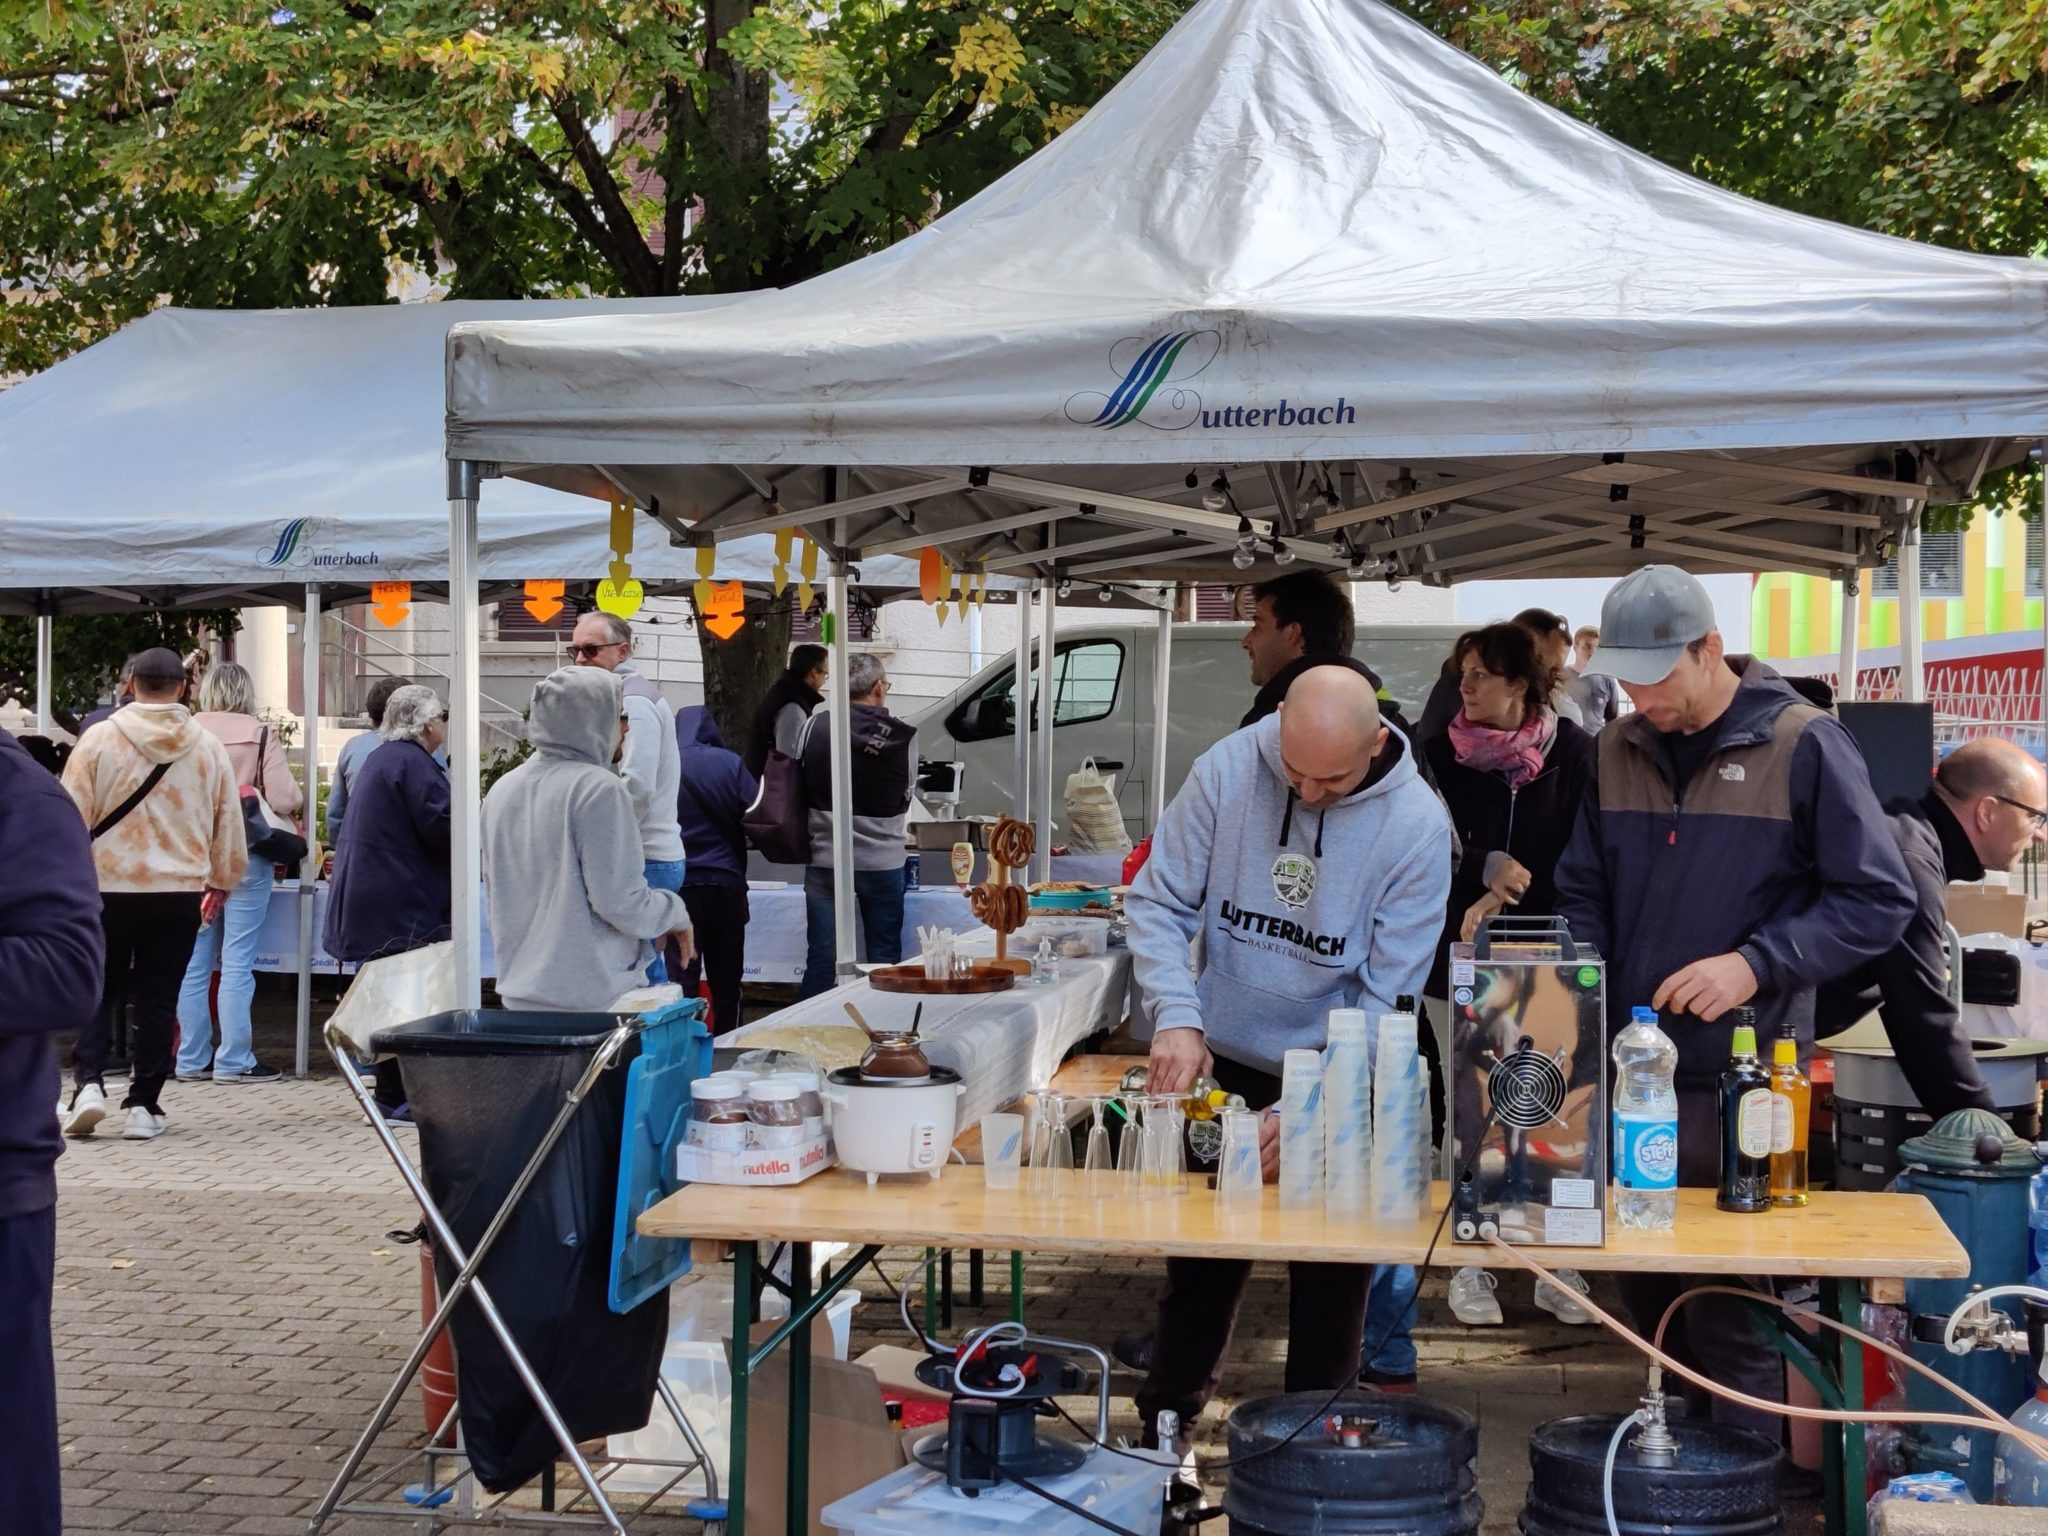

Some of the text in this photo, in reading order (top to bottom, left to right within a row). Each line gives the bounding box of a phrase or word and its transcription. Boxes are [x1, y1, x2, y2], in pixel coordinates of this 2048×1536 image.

[1220, 900, 1346, 956] LUTTERBACH
[1247, 937, 1308, 963] BASKETBALL
[743, 1160, 790, 1175] nutella
[800, 1146, 824, 1169] nutella
